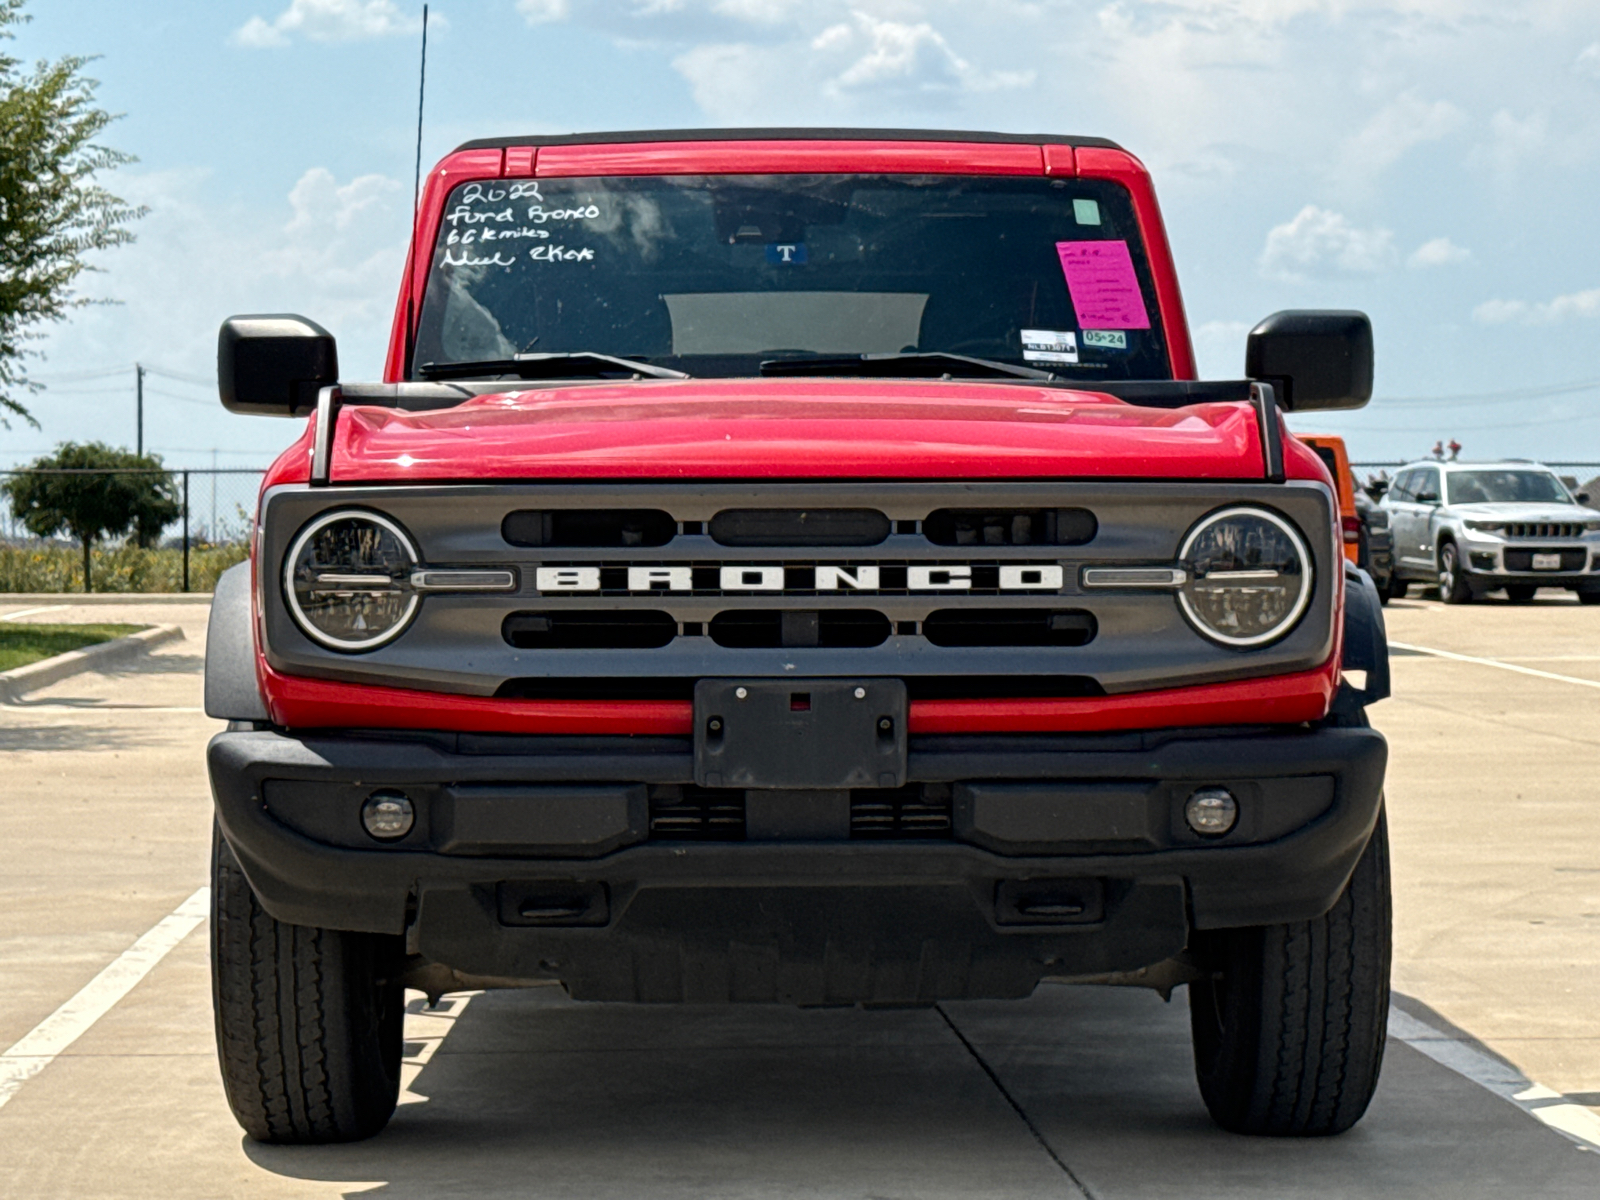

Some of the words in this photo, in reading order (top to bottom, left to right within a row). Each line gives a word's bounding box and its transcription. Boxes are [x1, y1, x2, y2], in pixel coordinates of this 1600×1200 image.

[463, 181, 543, 204] 2022
[528, 205, 600, 223] Bronco
[776, 245, 796, 261] T
[536, 565, 1064, 591] BRONCO
